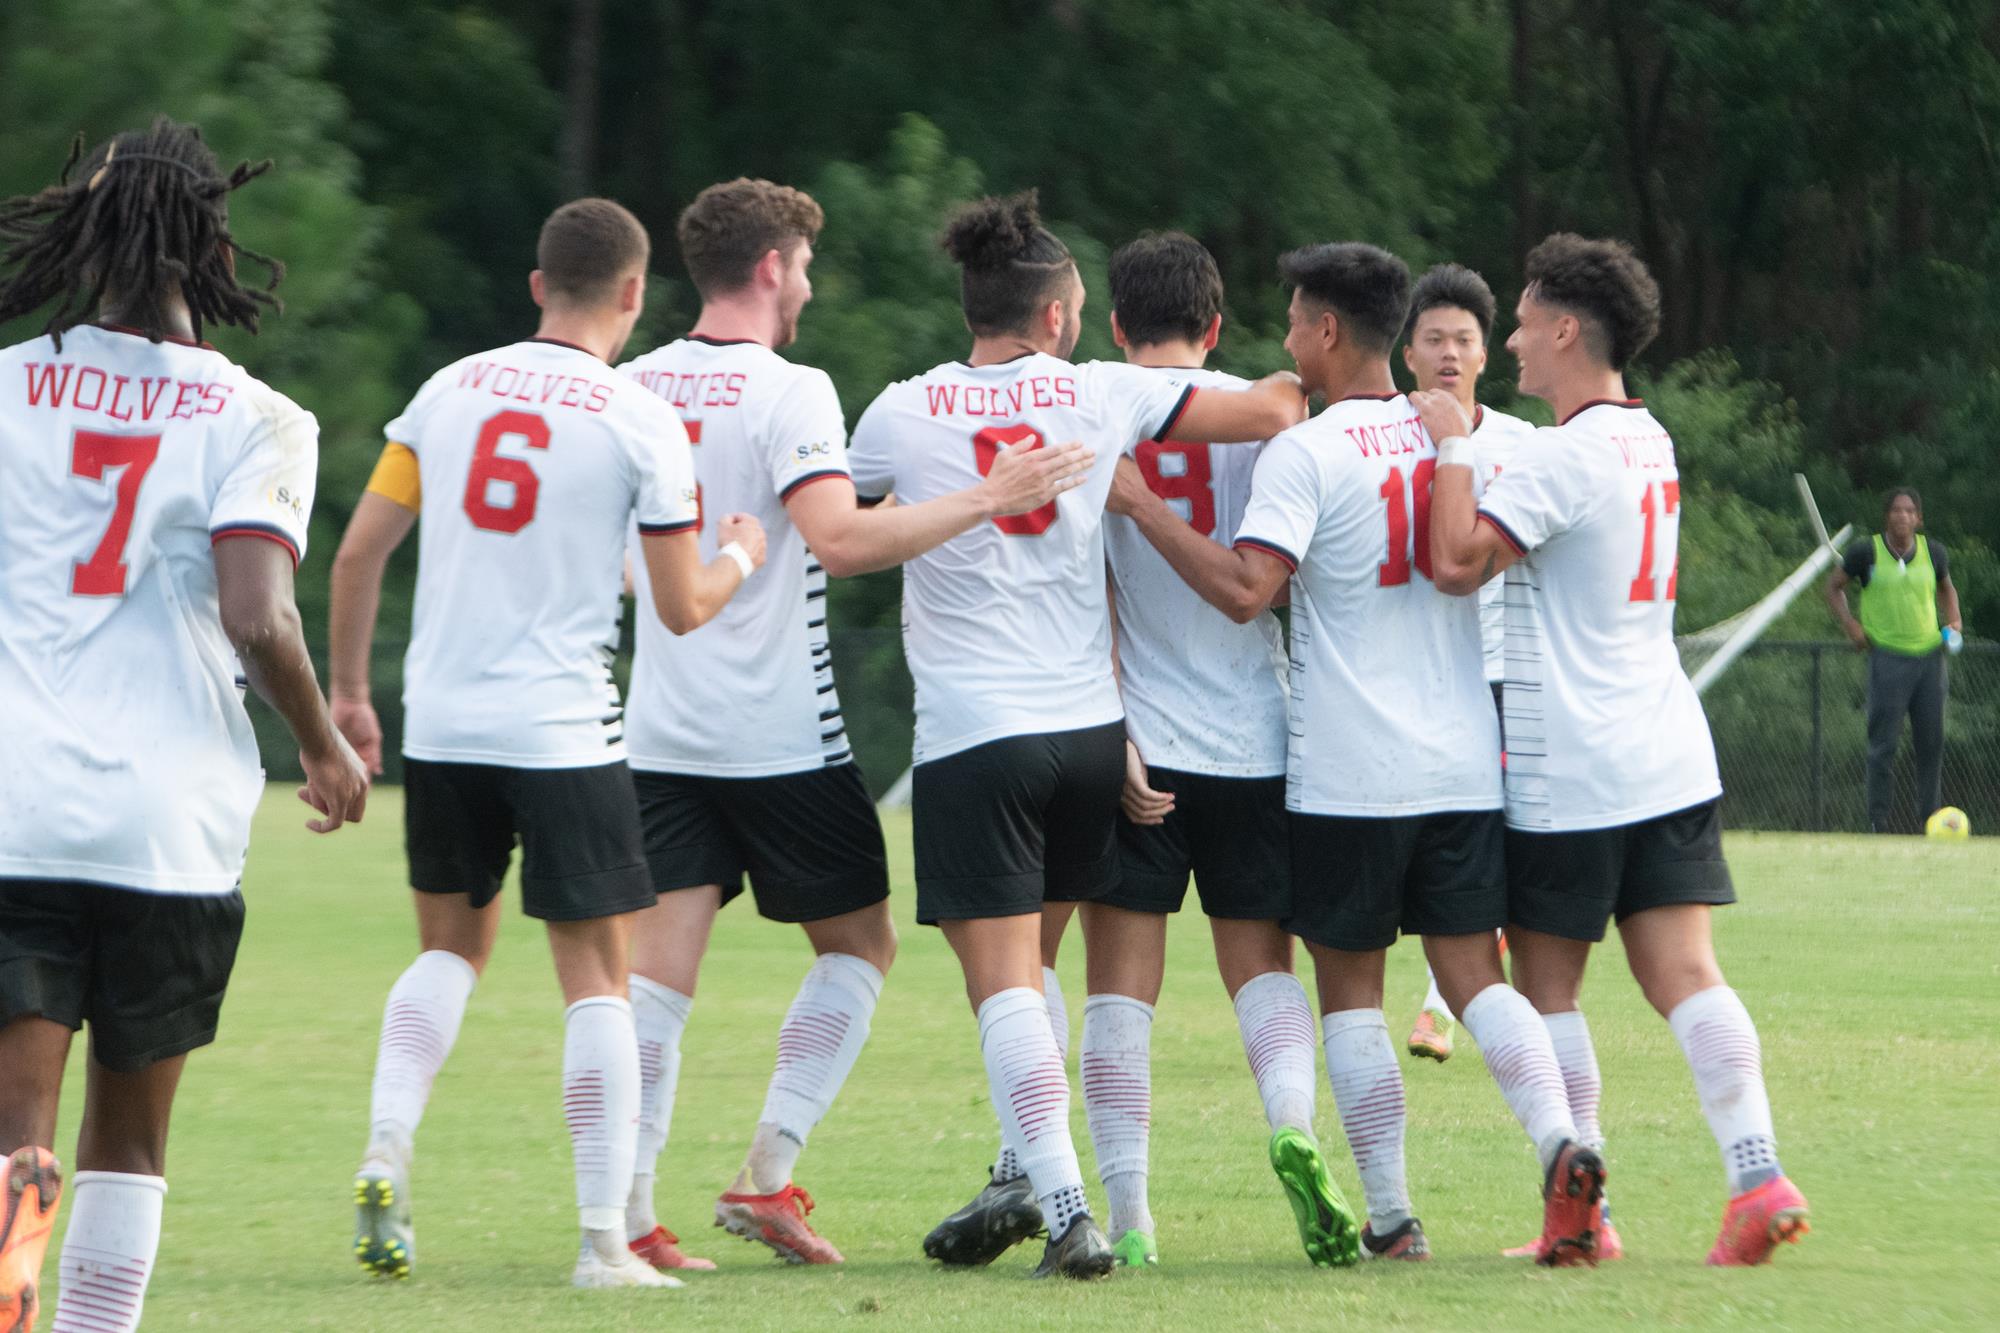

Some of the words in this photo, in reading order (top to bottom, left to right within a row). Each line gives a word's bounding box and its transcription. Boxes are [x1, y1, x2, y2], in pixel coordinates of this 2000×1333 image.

[24, 361, 234, 422] WOLVES
[457, 362, 615, 412] WOLVES
[926, 376, 1076, 417] WOLVES
[1345, 415, 1425, 457] WOLV
[462, 408, 552, 536] 6
[69, 426, 163, 598] 7
